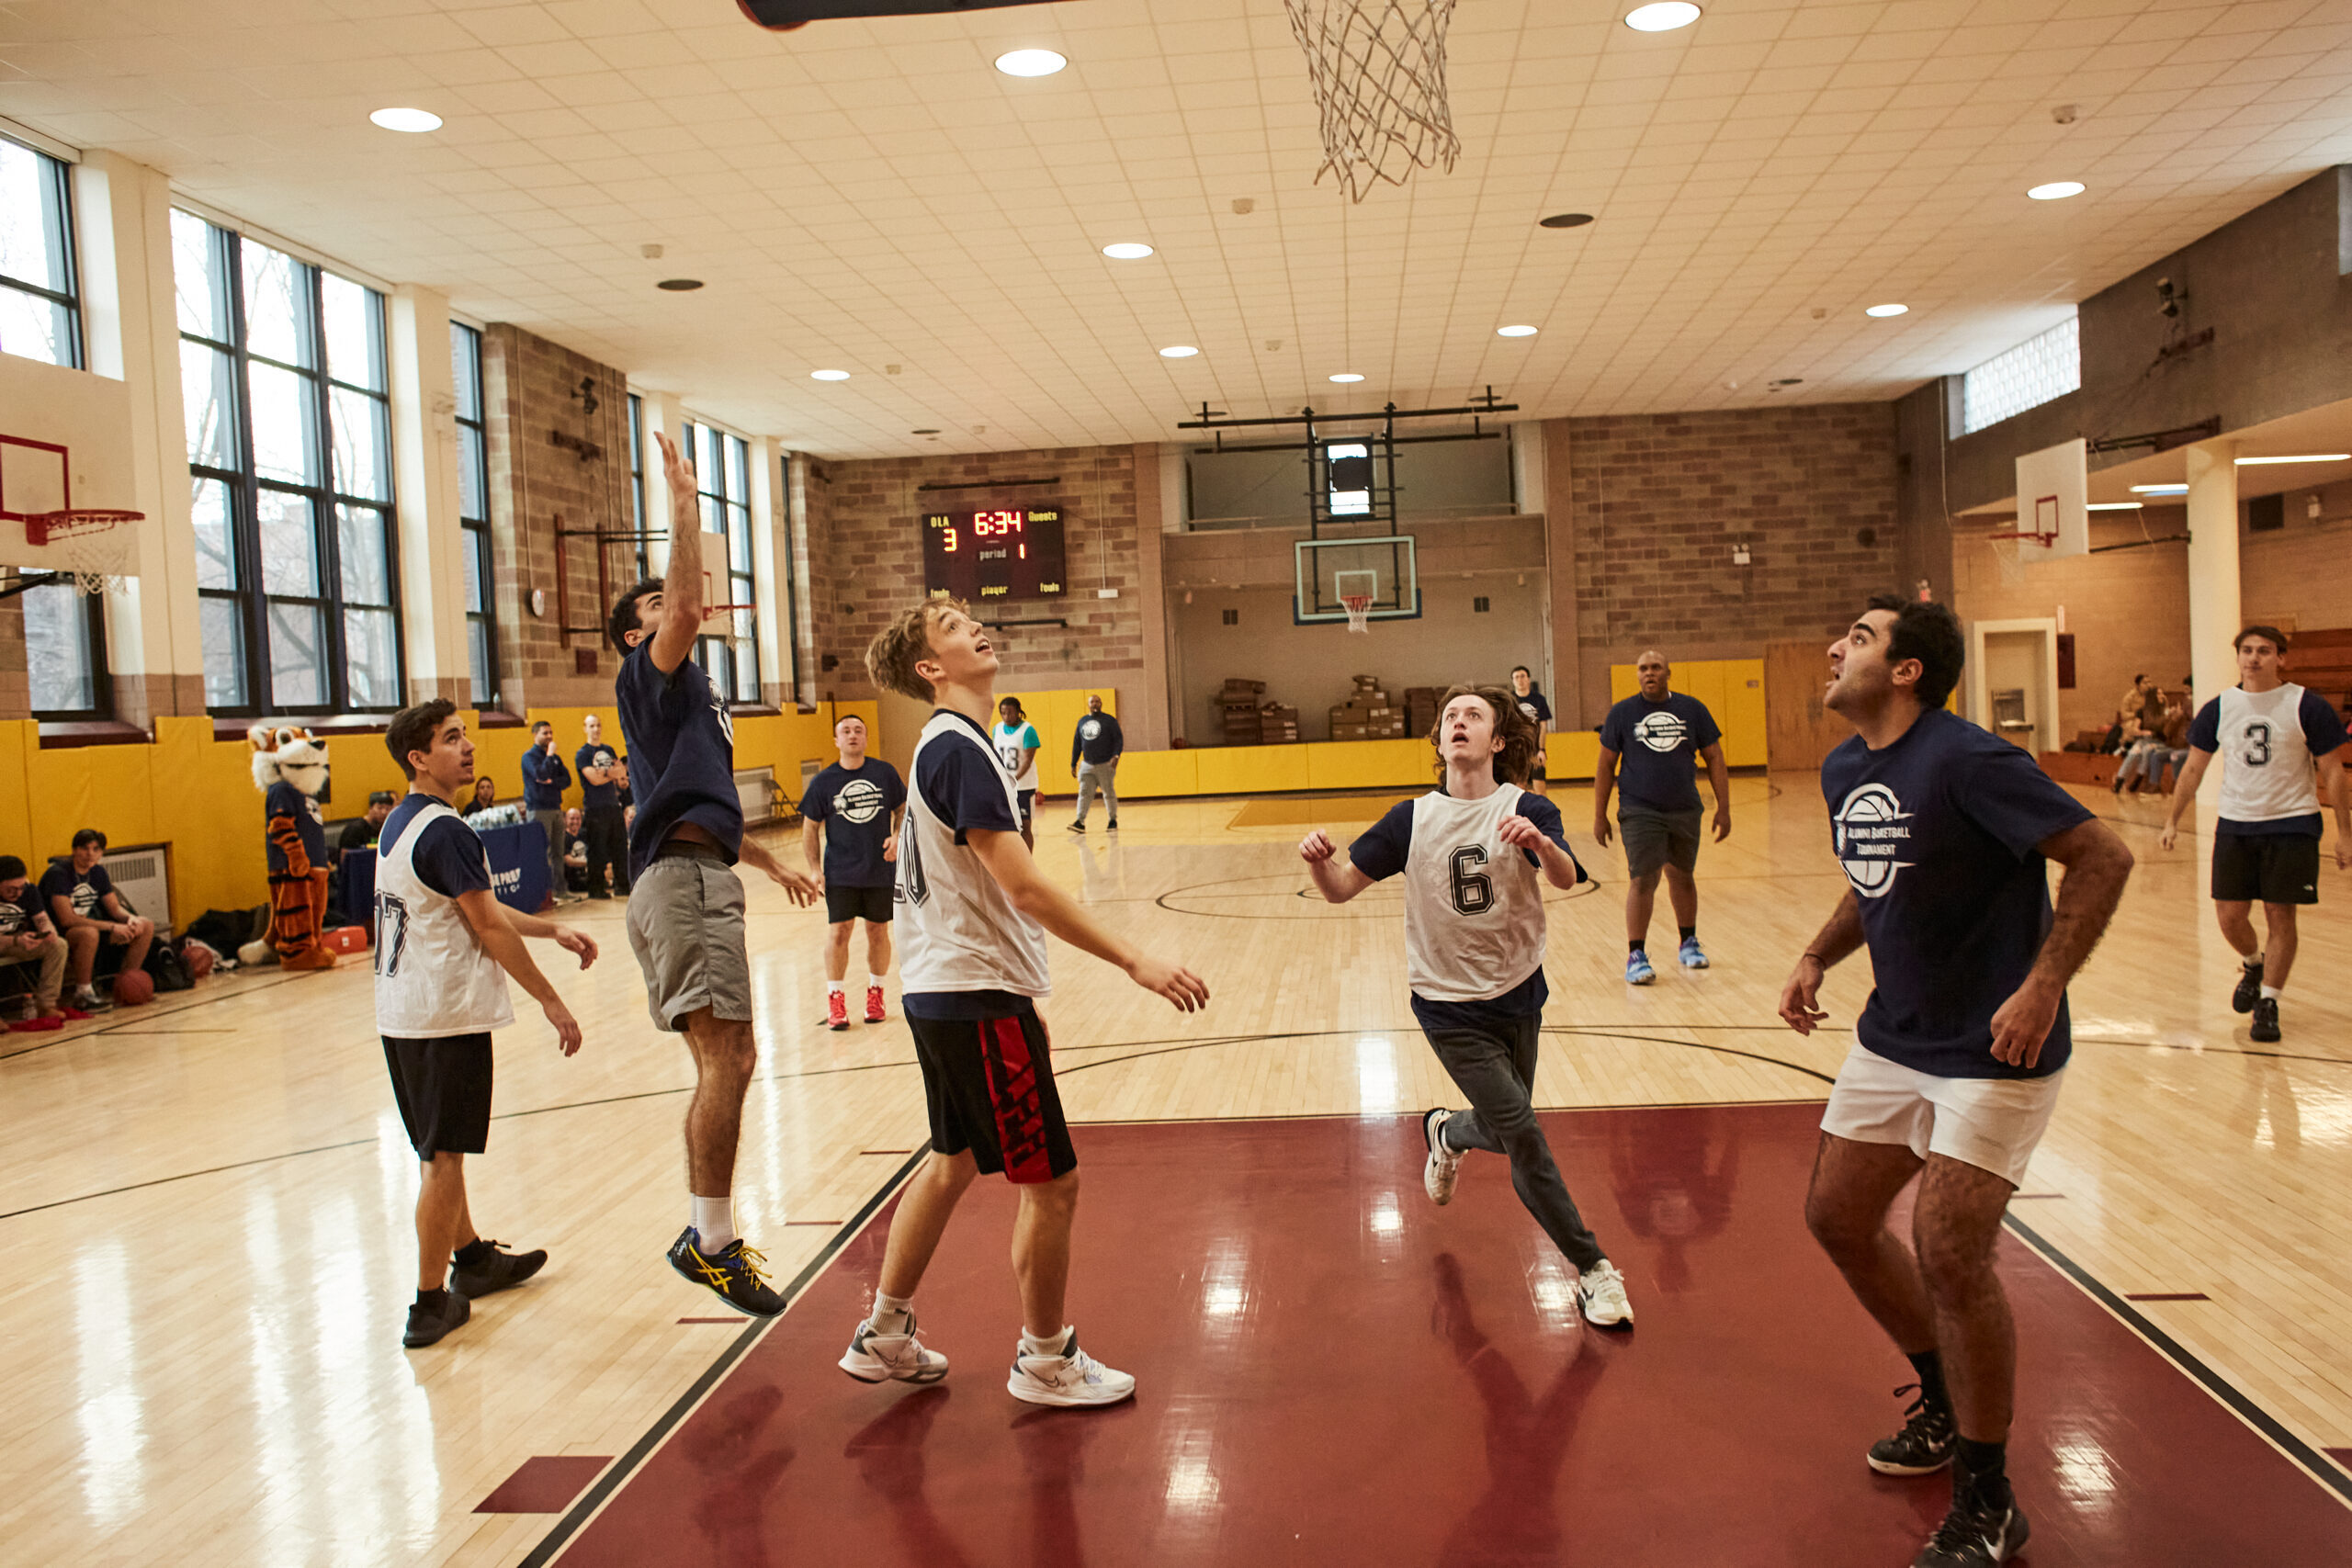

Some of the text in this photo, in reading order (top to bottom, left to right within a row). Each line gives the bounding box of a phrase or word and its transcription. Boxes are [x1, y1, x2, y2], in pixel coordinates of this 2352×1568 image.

[975, 511, 1022, 536] 6:34
[943, 528, 957, 552] 3
[1019, 543, 1025, 559] 1
[979, 547, 1007, 561] period
[980, 585, 1009, 597] player
[2244, 721, 2271, 768] 3
[1449, 843, 1495, 917] 6
